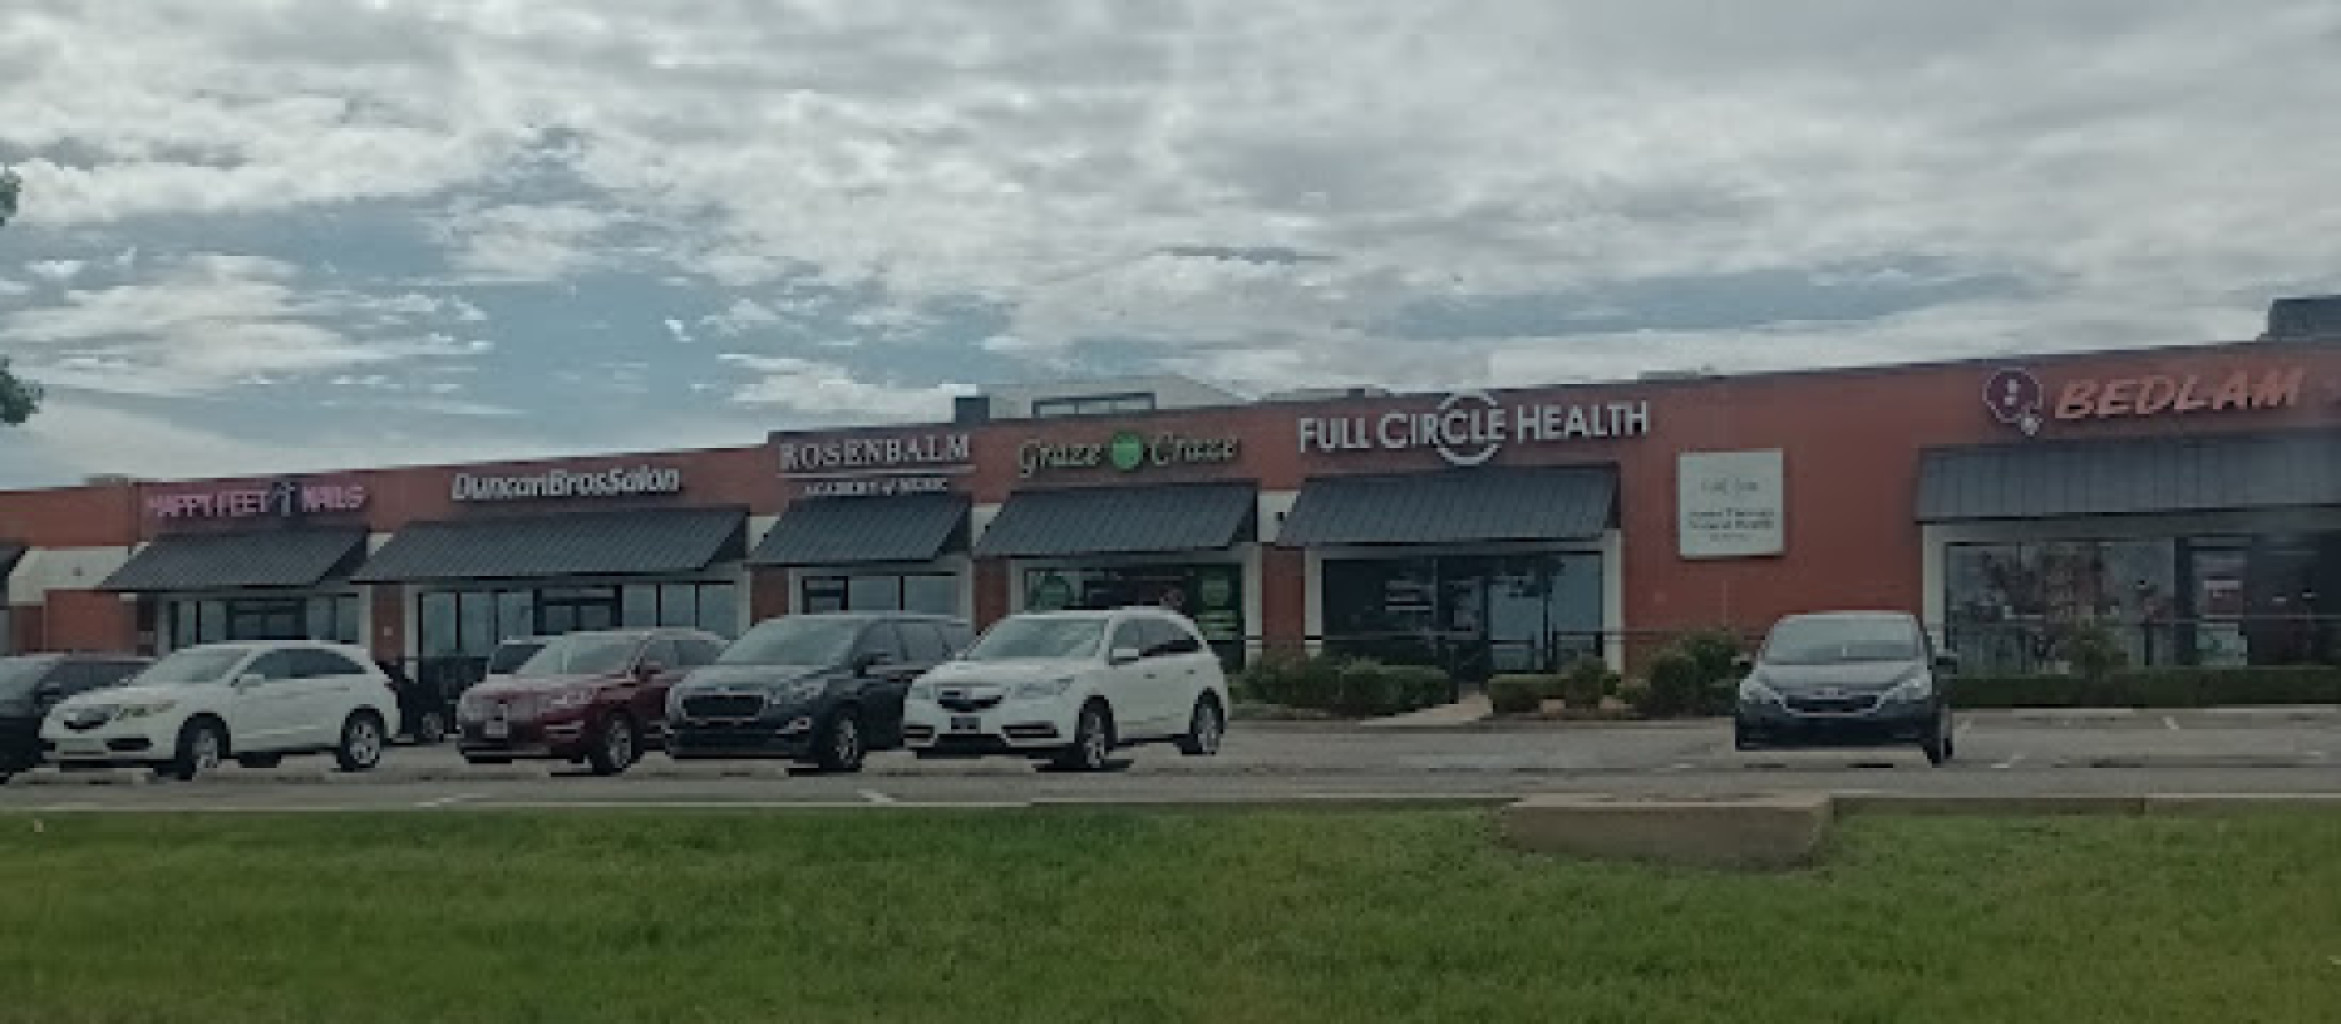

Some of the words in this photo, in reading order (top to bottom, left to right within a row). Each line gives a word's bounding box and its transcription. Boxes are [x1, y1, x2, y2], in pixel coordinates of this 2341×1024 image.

[2055, 369, 2303, 419] BEDLAM
[1299, 414, 1370, 453] FULL
[1377, 406, 1504, 447] CIRCLE
[1517, 400, 1649, 442] HEALTH
[779, 434, 971, 470] ROSENBALM
[1019, 439, 1100, 478] Graze
[148, 492, 214, 518] HAPPY
[216, 489, 269, 517] FEET
[302, 484, 365, 513] NAILS
